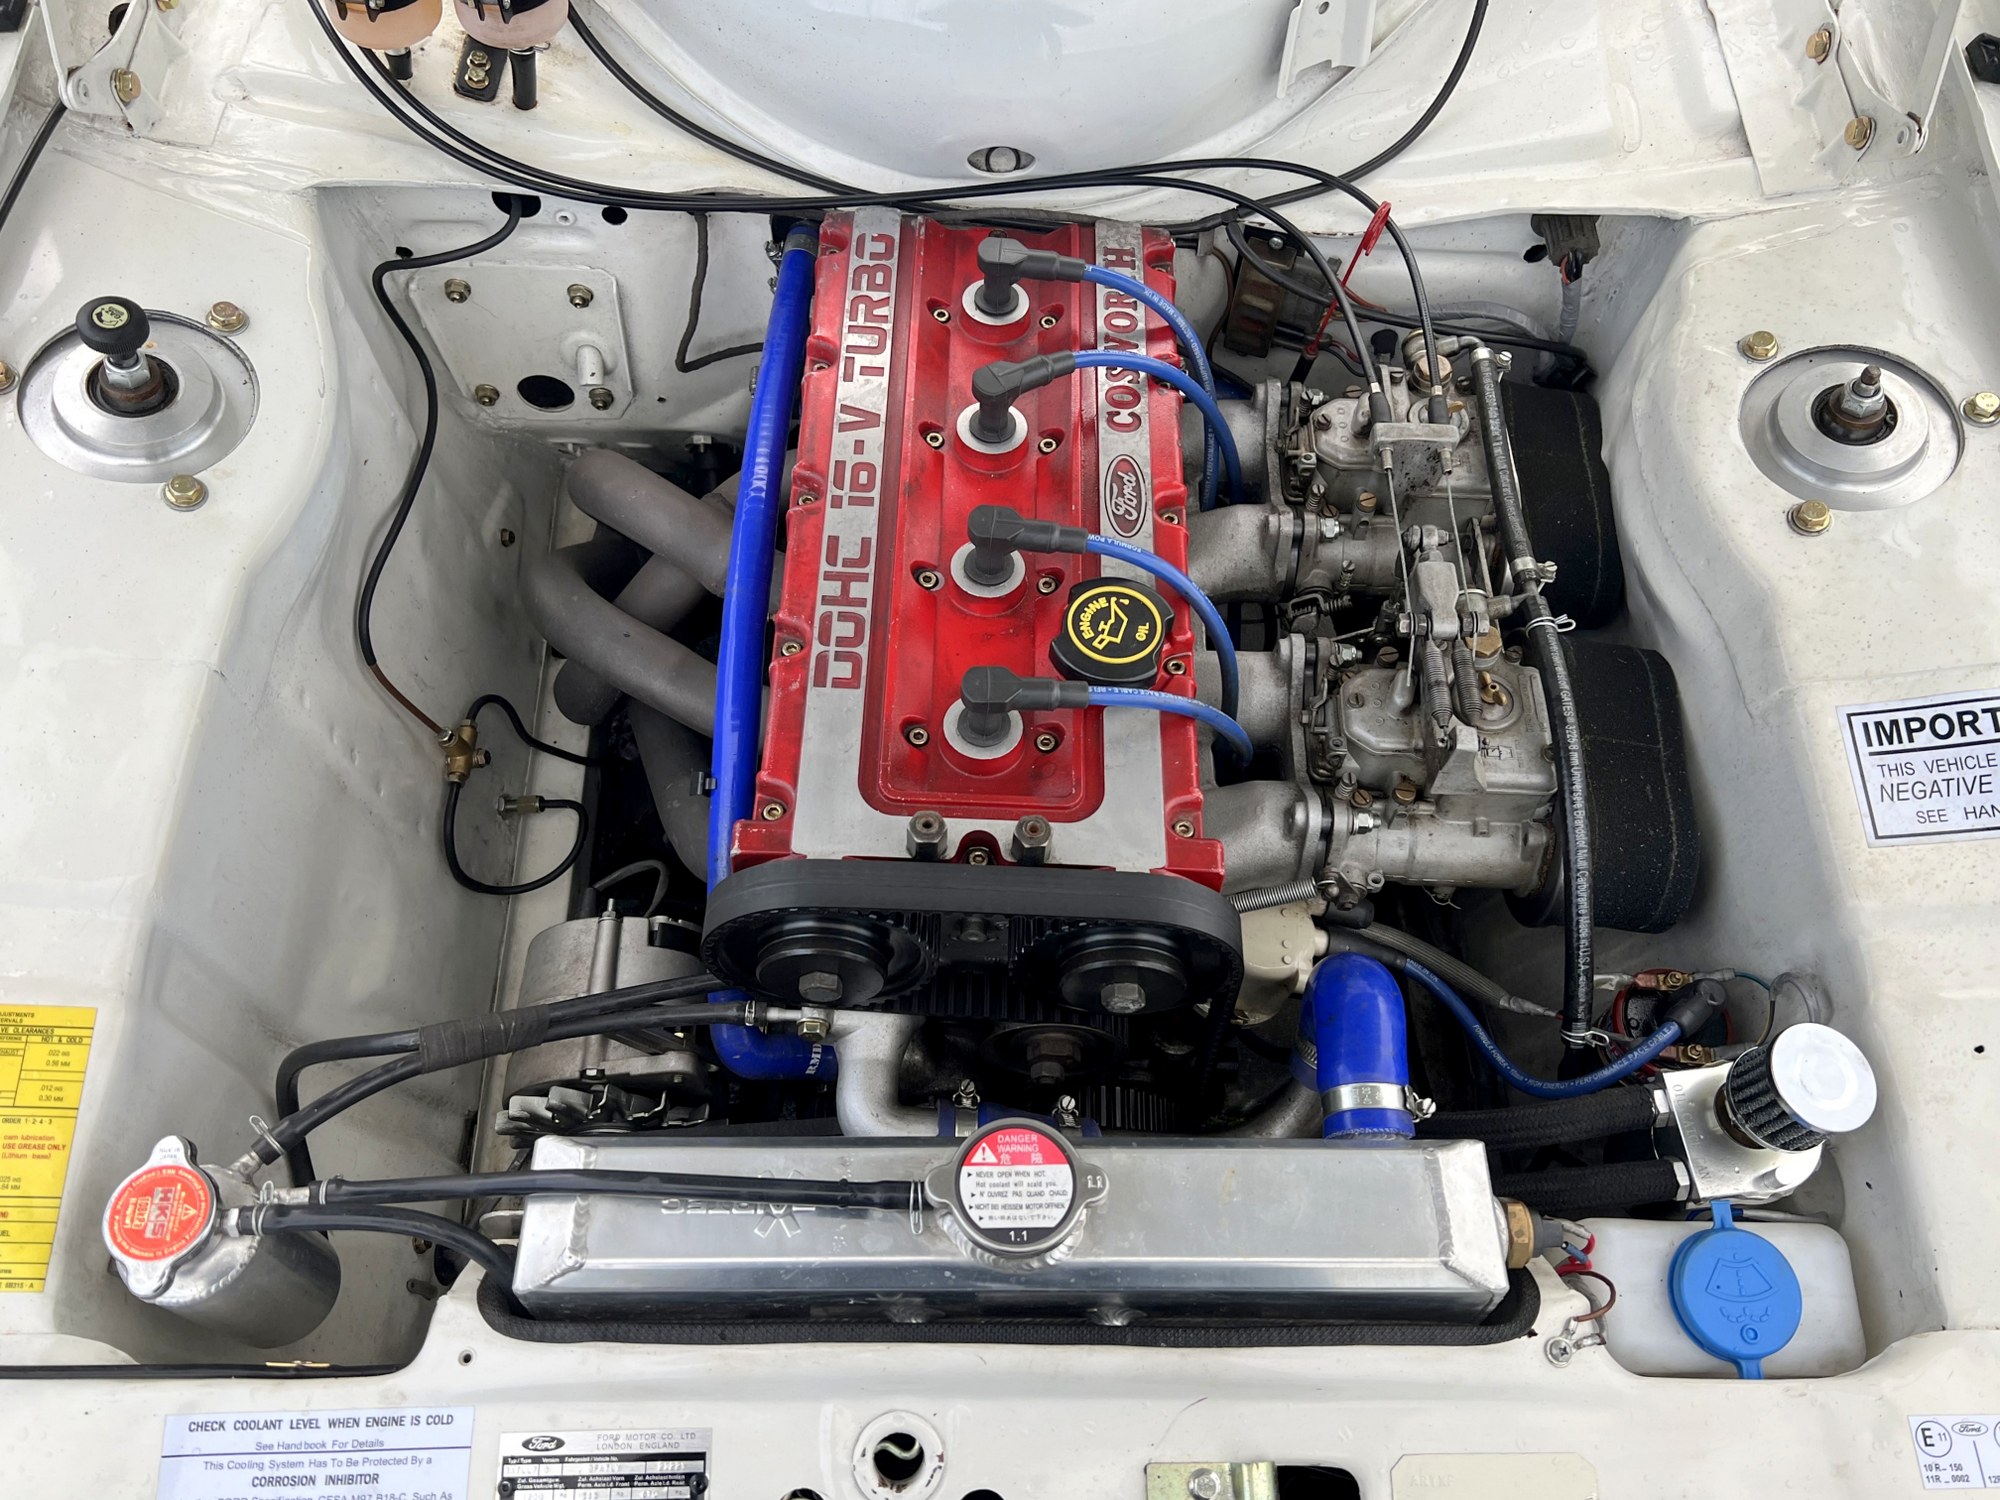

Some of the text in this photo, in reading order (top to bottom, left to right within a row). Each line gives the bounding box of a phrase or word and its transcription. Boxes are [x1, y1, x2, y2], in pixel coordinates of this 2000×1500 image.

[842, 232, 896, 382] TURBO
[1103, 246, 1142, 433] COSWORH
[829, 403, 882, 509] 16-V
[1111, 470, 1137, 522] Ford
[1106, 537, 1142, 554] FORMULA
[812, 535, 871, 690] DOHC
[1078, 595, 1111, 640] ENGINE
[1135, 621, 1150, 642] OIL
[1568, 751, 1580, 766] mm
[1876, 752, 1999, 779] THIS VEHICLE
[1880, 773, 1994, 803] NEGATIVE
[1915, 808, 1949, 825] SEE
[13, 1026, 55, 1035] CLEARANCES
[66, 1036, 84, 1044] COLD
[1490, 1049, 1509, 1068] POWER
[1575, 1058, 1629, 1087] PERFORMANCE
[1648, 1027, 1674, 1047] CABLE
[2, 1142, 67, 1151] USE GREASE ONLY
[997, 1134, 1039, 1143] DANGER
[996, 1143, 1040, 1153] WARNING
[1014, 1170, 1031, 1178] WHEN
[1013, 1180, 1024, 1188] will
[987, 1190, 1009, 1198] OUVREZ
[1012, 1190, 1023, 1198] PAS
[1026, 1190, 1046, 1198] QUAND
[147, 1187, 174, 1238] HKS
[1009, 1230, 1028, 1242] 1.1
[188, 1413, 454, 1433] CHECK COOLANT LEVEL WHEN ENGINE IS COLD
[1958, 1423, 1982, 1433] Ford
[255, 1441, 275, 1452] See
[332, 1438, 350, 1450] For
[352, 1438, 385, 1449] Details
[528, 1436, 557, 1449] Ford
[597, 1433, 622, 1442] FORD
[626, 1432, 654, 1441] MOTOR
[680, 1432, 697, 1440] LTD
[1920, 1427, 1948, 1448] E 11
[596, 1440, 681, 1451] LONDON ENGLAND
[203, 1455, 433, 1472] This Cooling System Has To Be Protected By a
[251, 1472, 380, 1488] CORROSION INHIBITOR
